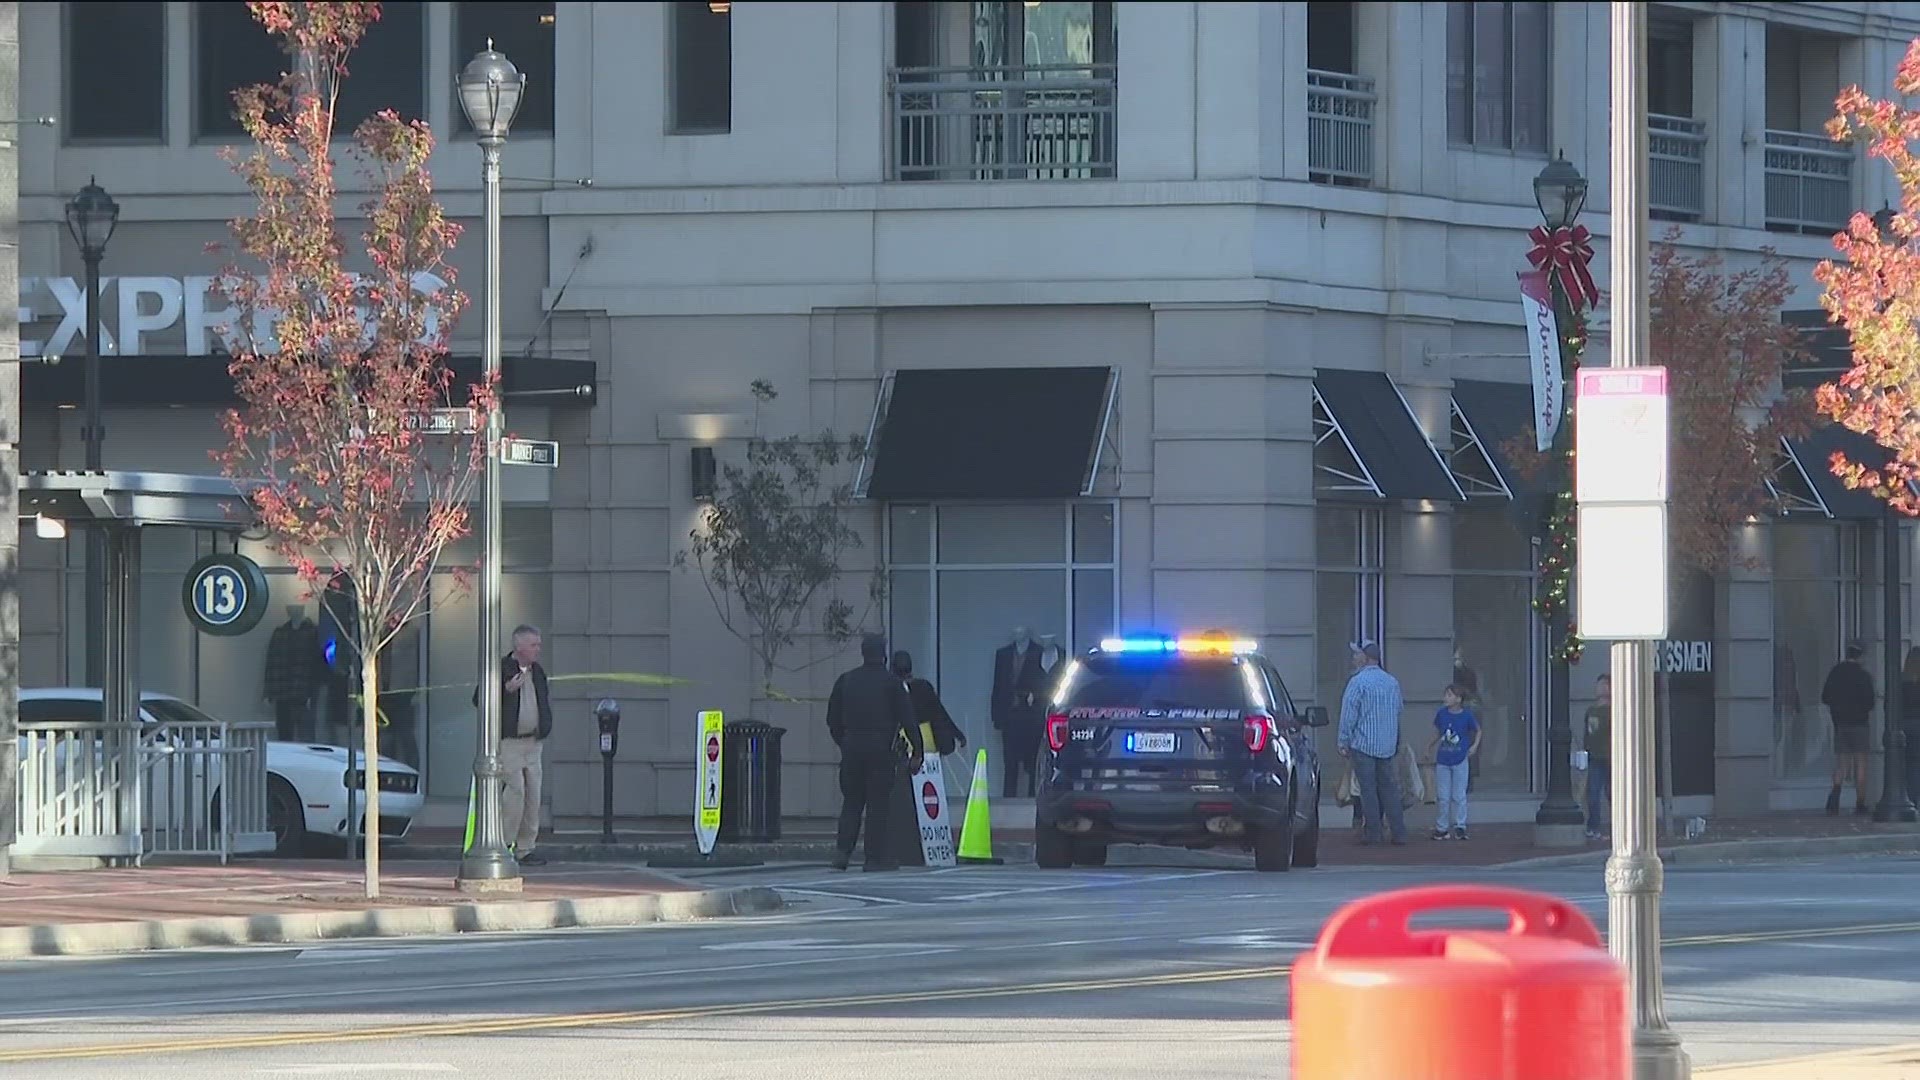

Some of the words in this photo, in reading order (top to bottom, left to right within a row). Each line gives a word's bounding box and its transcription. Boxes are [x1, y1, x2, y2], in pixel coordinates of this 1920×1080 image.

[203, 575, 236, 614] 13
[1168, 708, 1241, 719] POLICE
[922, 826, 934, 840] DO
[935, 825, 950, 841] NOT
[927, 845, 950, 861] ENTER
